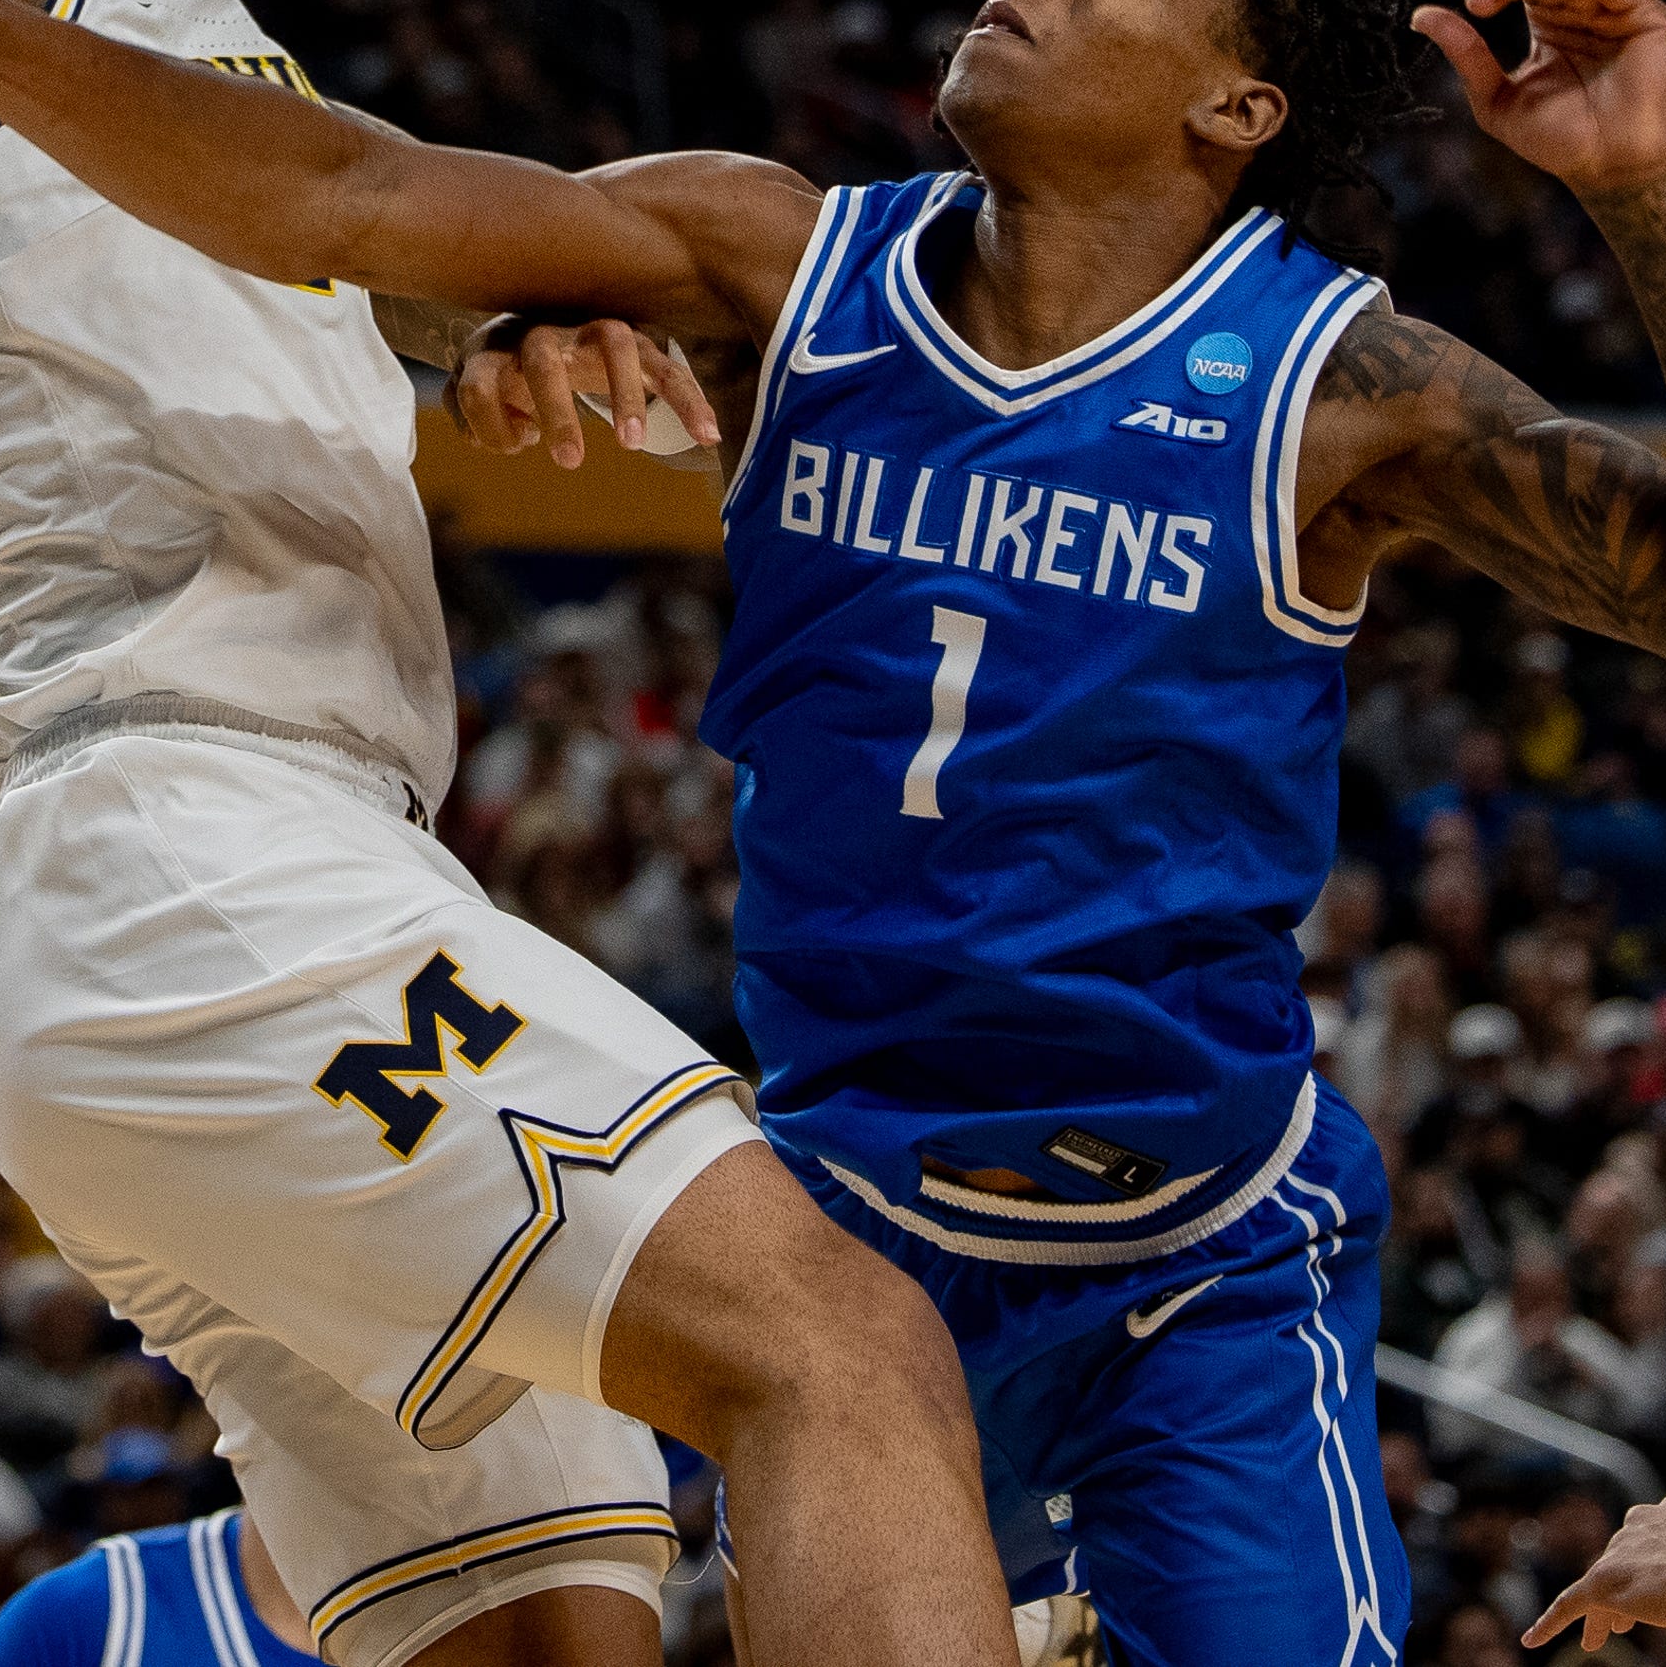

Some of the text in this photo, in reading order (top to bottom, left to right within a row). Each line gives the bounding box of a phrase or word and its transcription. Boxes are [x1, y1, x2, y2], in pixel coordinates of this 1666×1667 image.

[1119, 401, 1227, 441] A10
[1193, 358, 1247, 382] NCAA
[780, 438, 1213, 613] BILLIKENS
[899, 605, 987, 819] 1
[310, 947, 529, 1163] M
[1123, 1166, 1137, 1183] L
